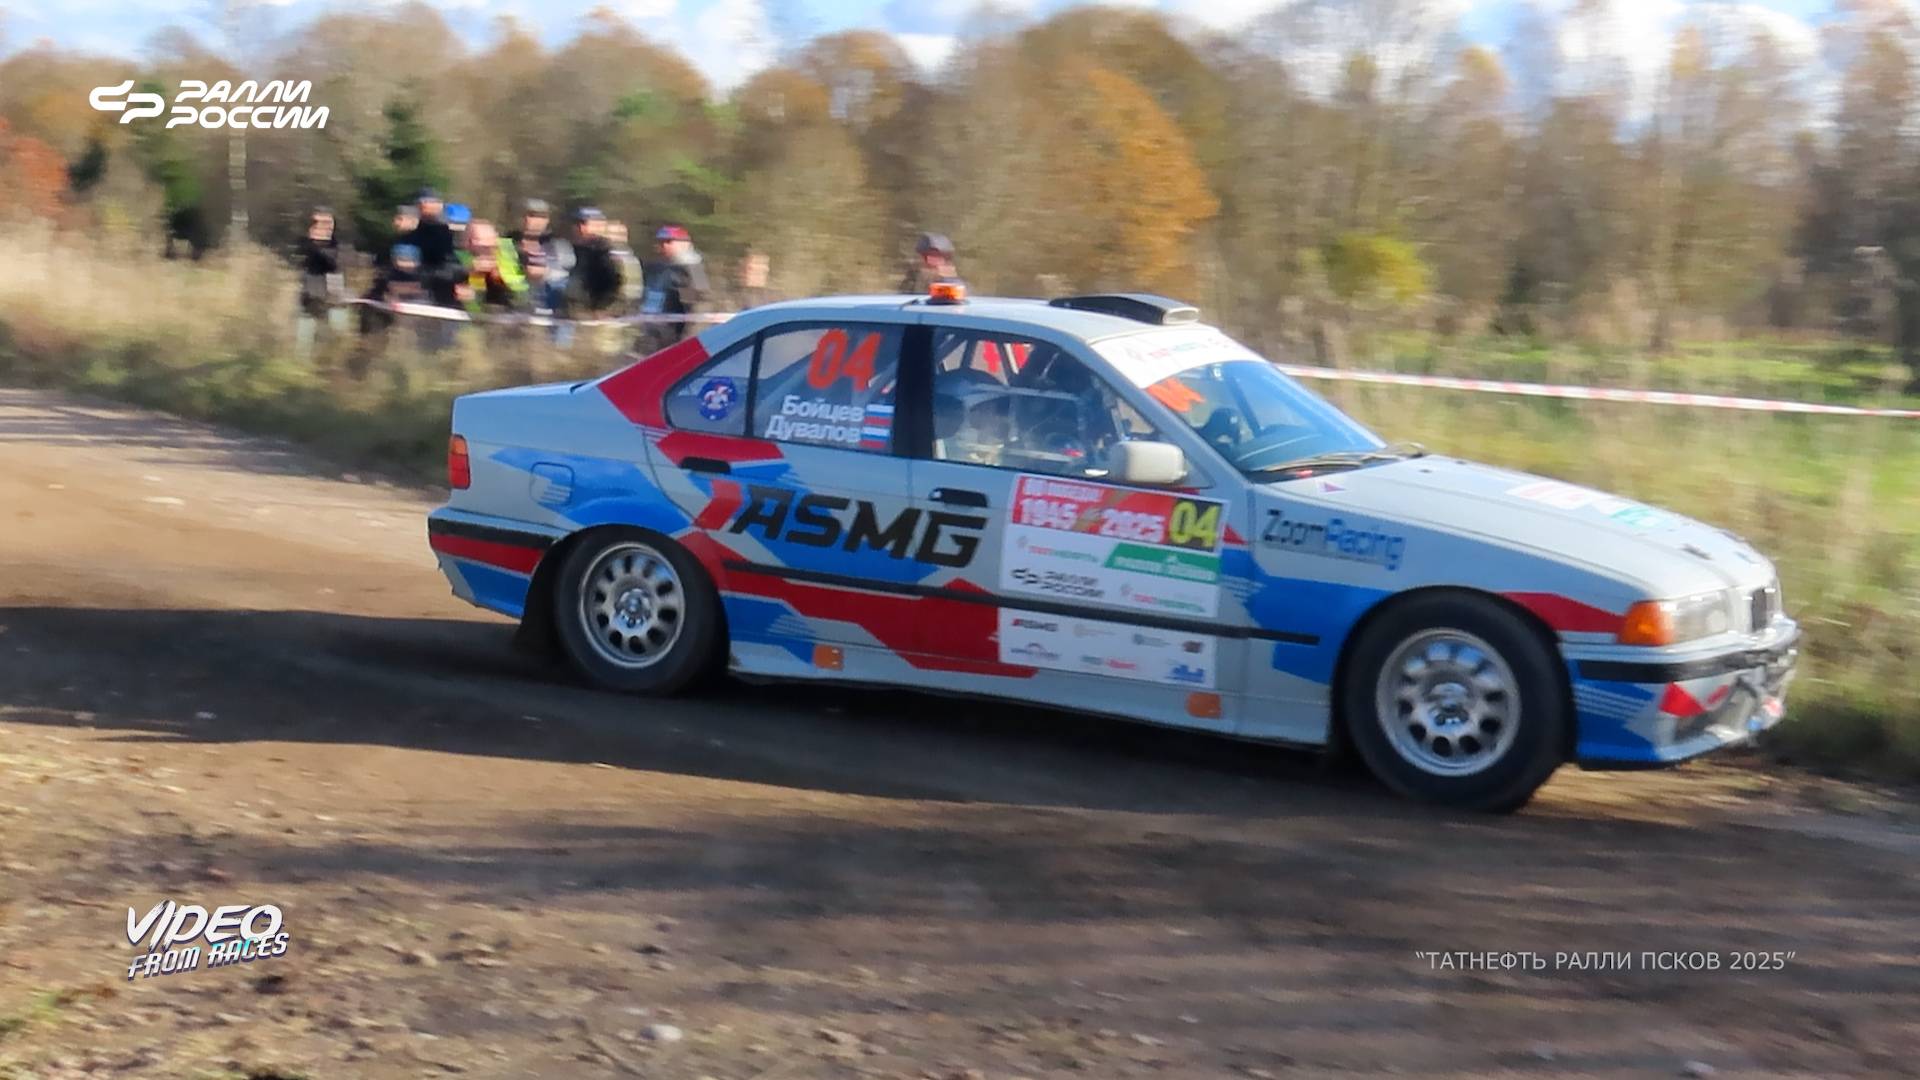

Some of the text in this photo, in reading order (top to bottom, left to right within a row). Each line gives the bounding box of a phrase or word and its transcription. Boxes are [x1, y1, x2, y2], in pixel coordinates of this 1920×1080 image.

[806, 327, 883, 393] 04
[763, 414, 863, 443] Дувалов
[781, 393, 865, 423] Бойцев
[728, 483, 989, 569] ASMG
[1098, 508, 1166, 543] 2025
[1169, 501, 1220, 548] 04
